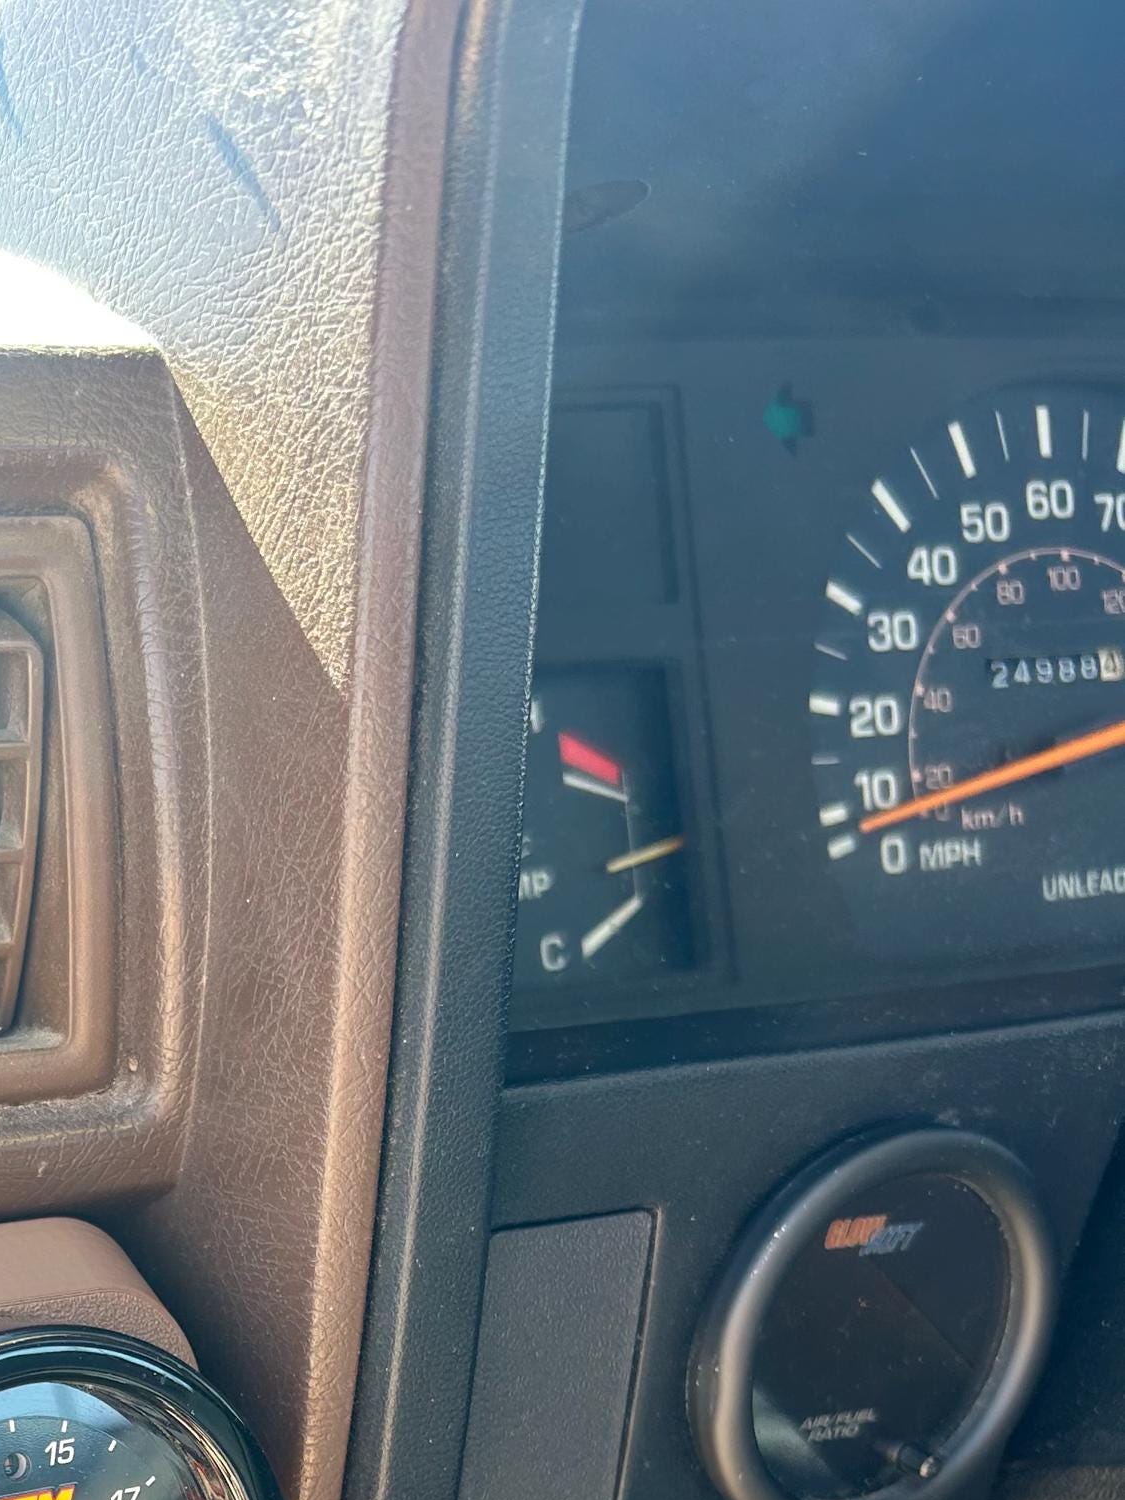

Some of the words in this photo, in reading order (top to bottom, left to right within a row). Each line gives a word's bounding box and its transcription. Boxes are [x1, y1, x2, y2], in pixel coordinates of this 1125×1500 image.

[1026, 480, 1074, 519] 60
[960, 503, 1011, 543] 50
[907, 546, 958, 587] 40
[1047, 566, 1081, 591] 100
[996, 579, 1025, 605] 80
[868, 610, 919, 653] 30
[849, 697, 902, 739] 20
[855, 769, 899, 810] 10
[961, 801, 1024, 831] km/h
[880, 836, 908, 875] 0
[919, 838, 982, 871] MPH
[540, 933, 567, 972] C
[45, 1438, 75, 1466] 15
